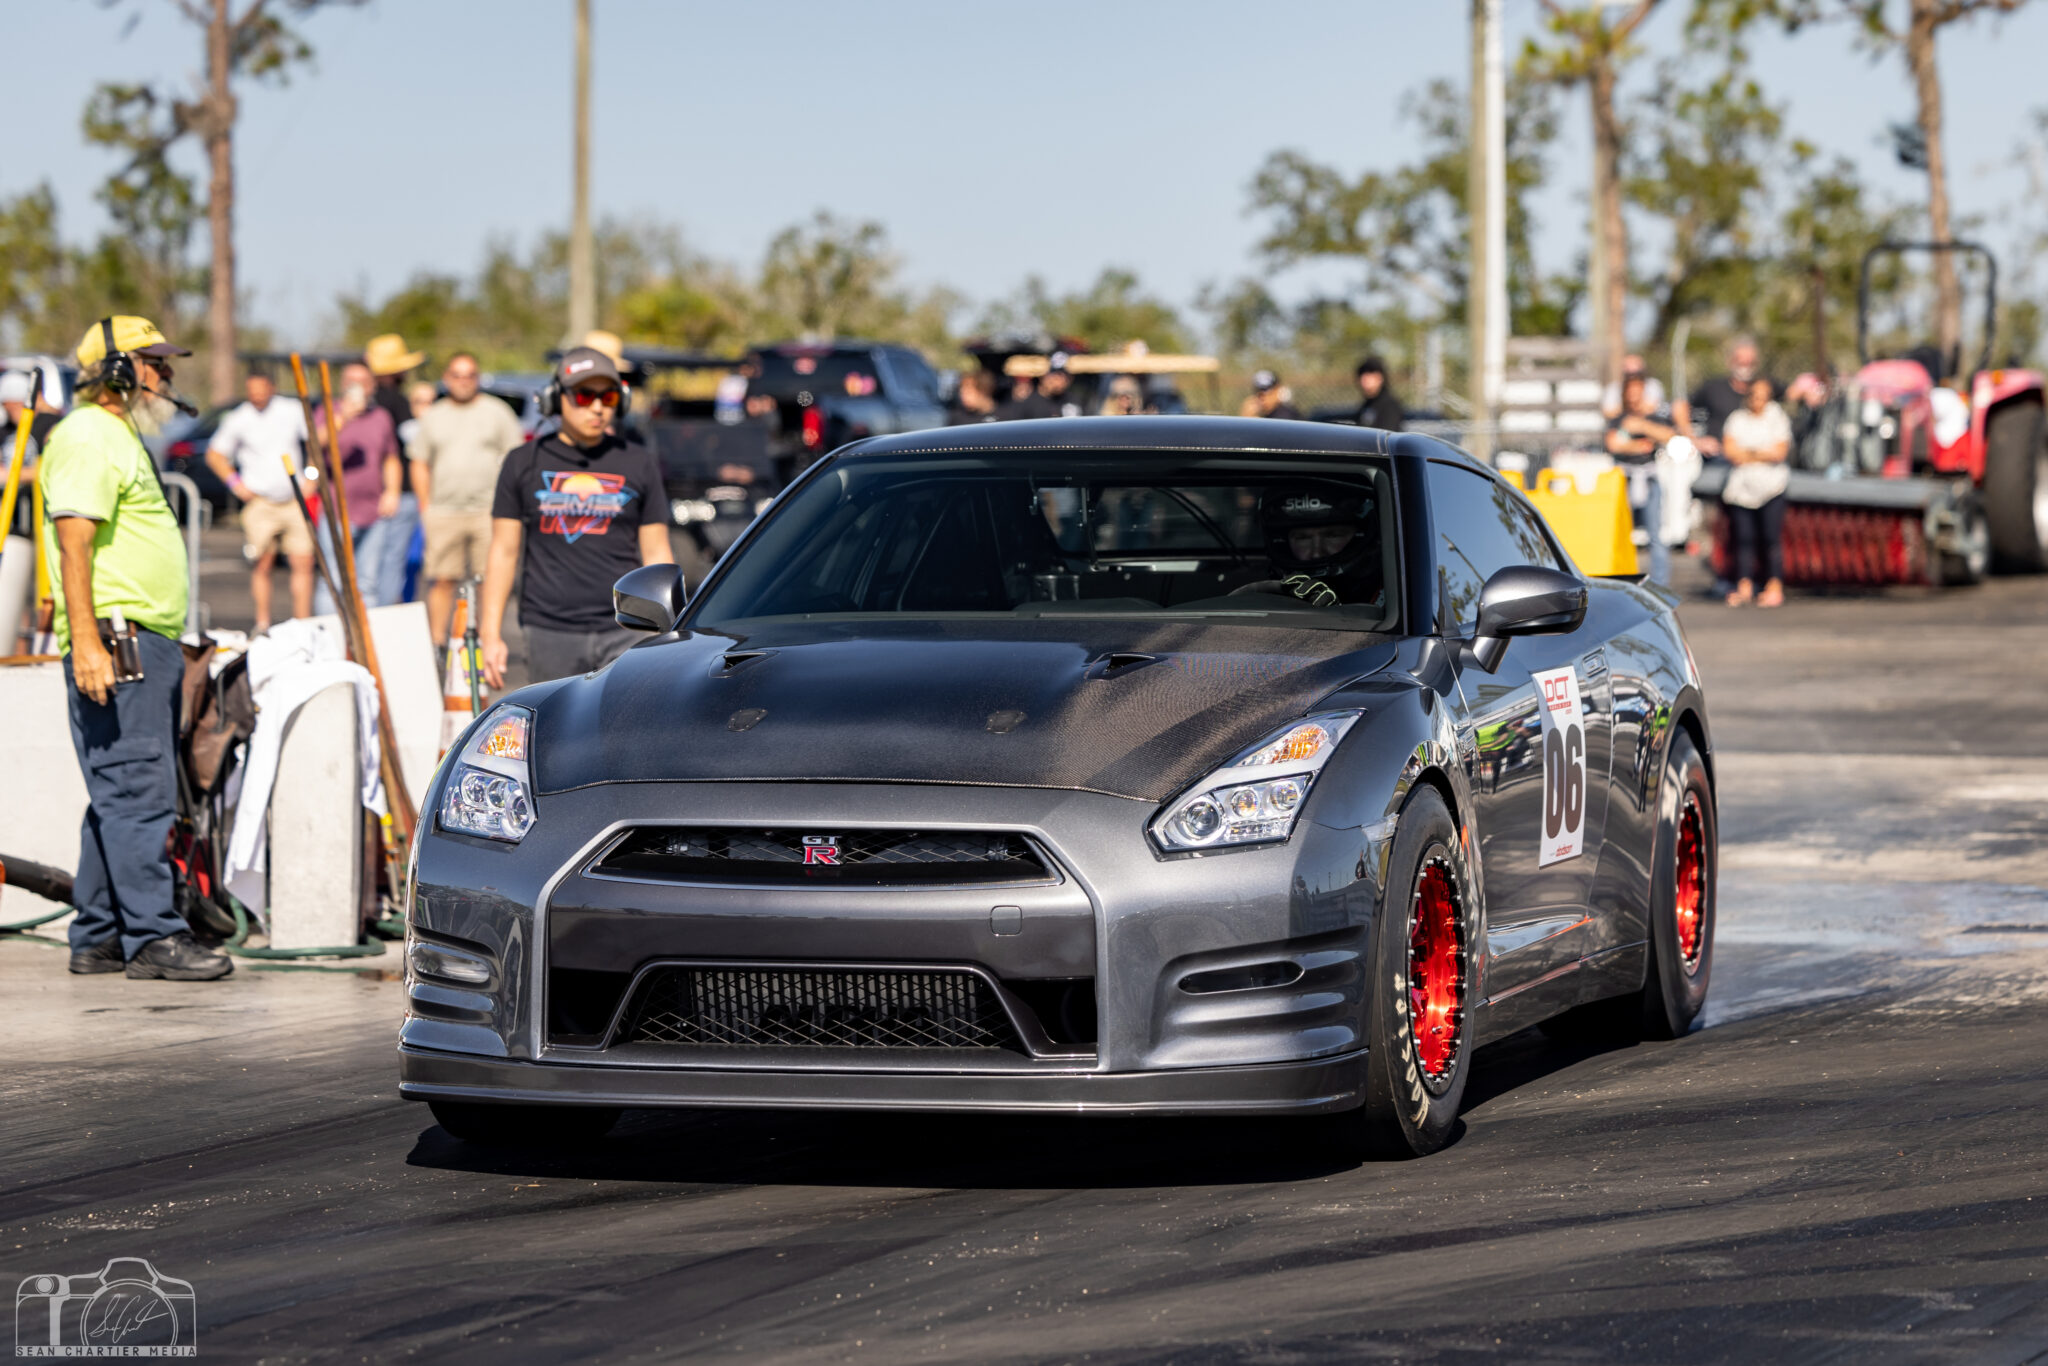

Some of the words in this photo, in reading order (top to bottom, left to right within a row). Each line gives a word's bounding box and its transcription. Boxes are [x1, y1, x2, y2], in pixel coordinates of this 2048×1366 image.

[1285, 494, 1320, 509] stilo
[1545, 676, 1569, 702] DCT
[1546, 723, 1582, 839] 06
[802, 836, 842, 844] GT
[802, 846, 841, 864] R
